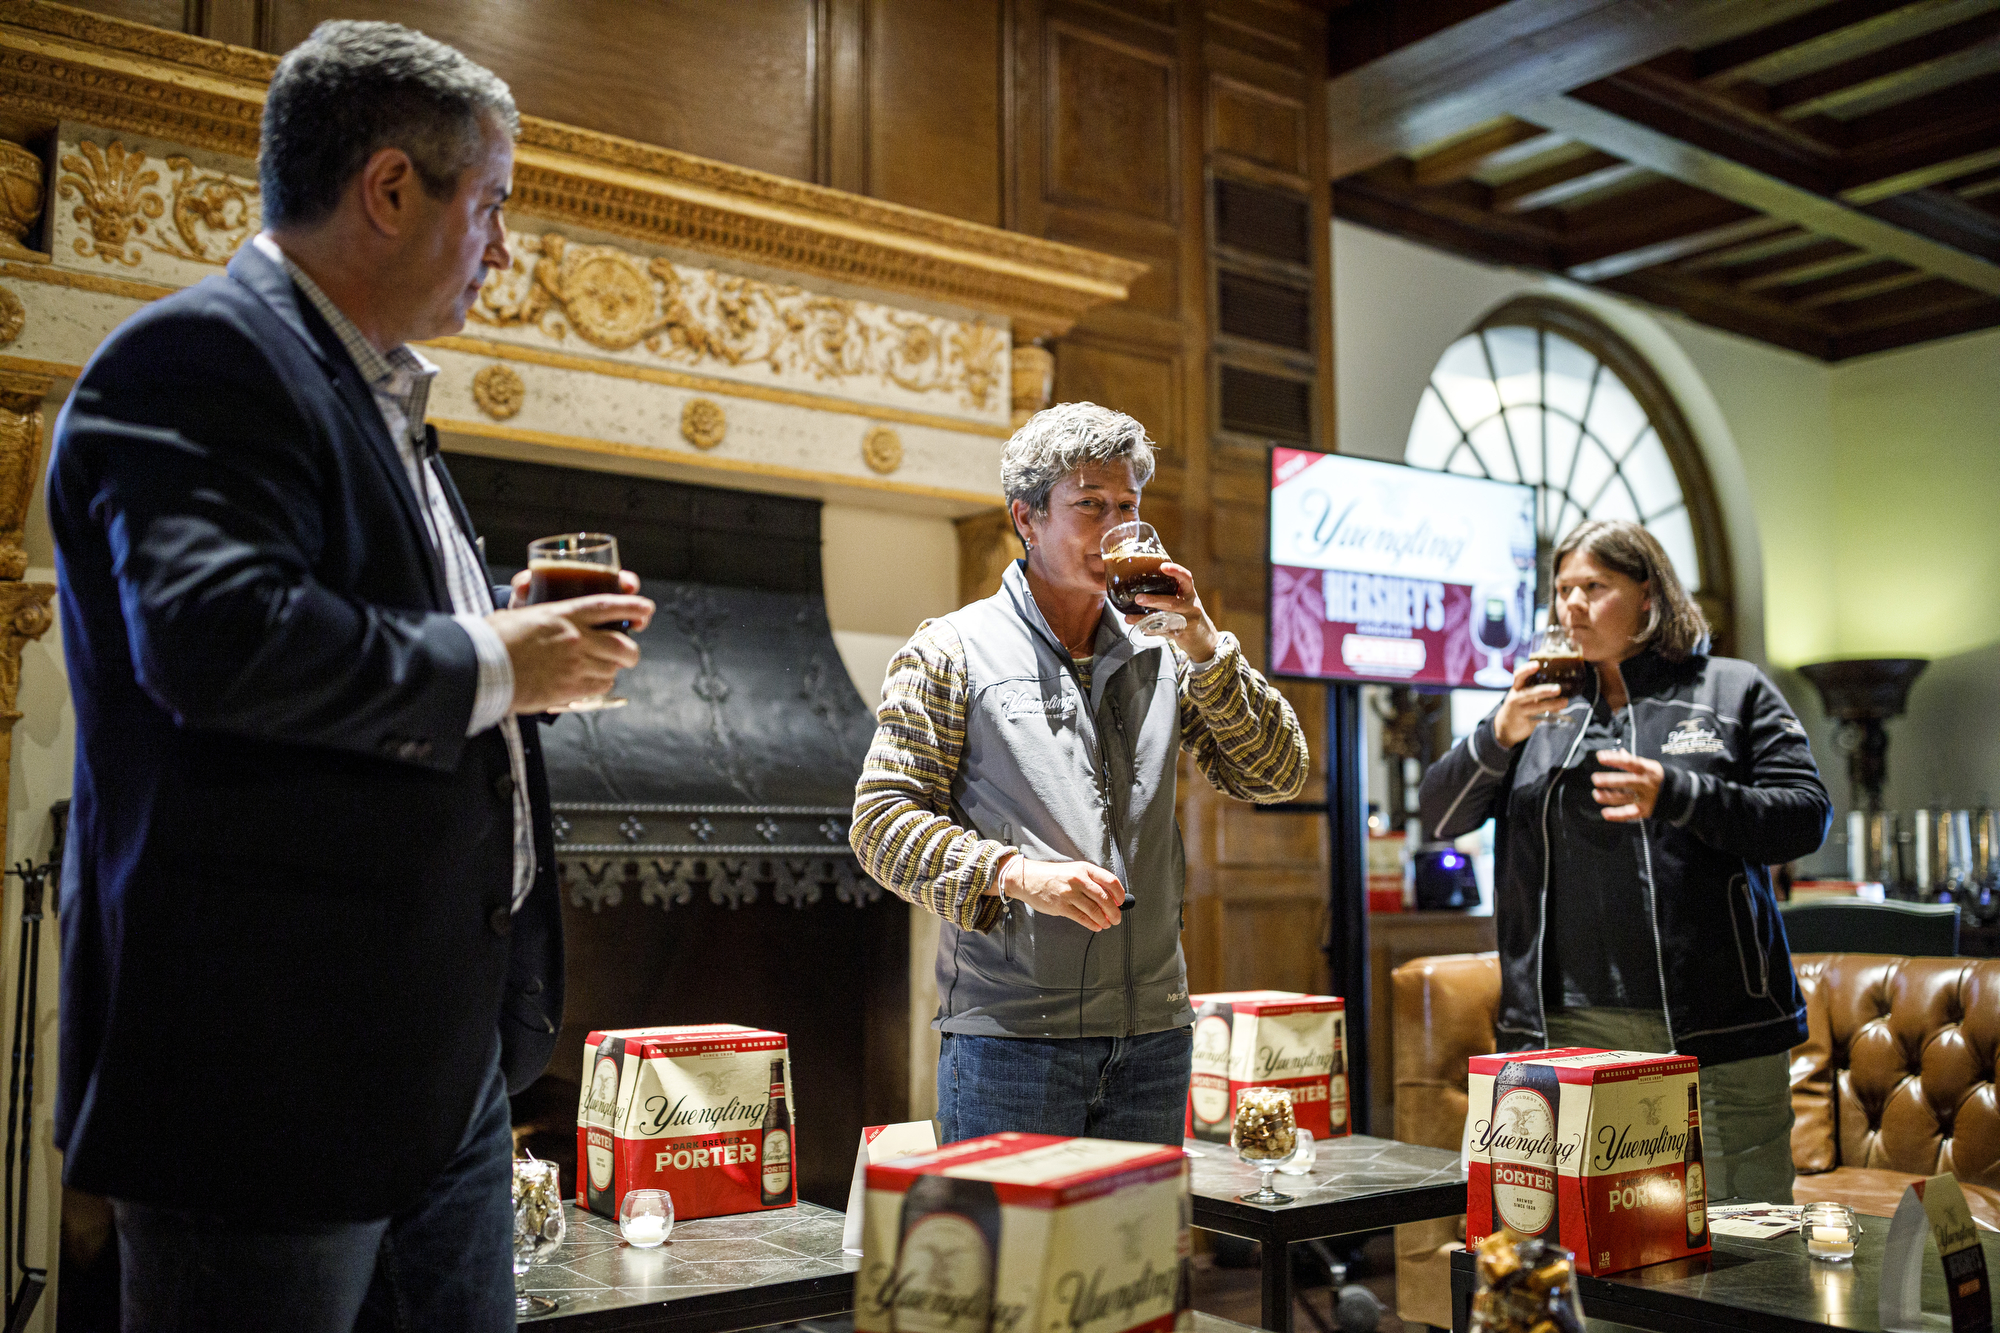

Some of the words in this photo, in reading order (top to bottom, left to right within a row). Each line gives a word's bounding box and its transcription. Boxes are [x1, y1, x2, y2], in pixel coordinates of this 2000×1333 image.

[1002, 687, 1077, 713] Yuengling
[650, 1046, 697, 1055] AMERICA'S
[702, 1043, 737, 1051] OLDEST
[1254, 1046, 1334, 1078] Yuengling
[1601, 1069, 1636, 1078] AMERICA'S
[1639, 1066, 1663, 1074] OLDEST
[1291, 1085, 1328, 1104] RTER
[638, 1092, 771, 1135] Yuengling
[587, 1131, 613, 1149] PORTER
[868, 1128, 881, 1140] NEW!
[673, 1142, 699, 1150] DARK
[702, 1137, 740, 1147] BREWED
[1470, 1119, 1581, 1165] Yuengling
[1594, 1119, 1688, 1171] Yuengling
[655, 1143, 757, 1172] PORTER
[763, 1164, 789, 1174] PORTER
[1503, 1163, 1519, 1171] DARK
[1520, 1166, 1546, 1175] BREWED
[1495, 1168, 1554, 1191] PORTER
[1621, 1177, 1641, 1188] DARK
[1687, 1201, 1704, 1213] PORTE
[1600, 1251, 1611, 1261] 12
